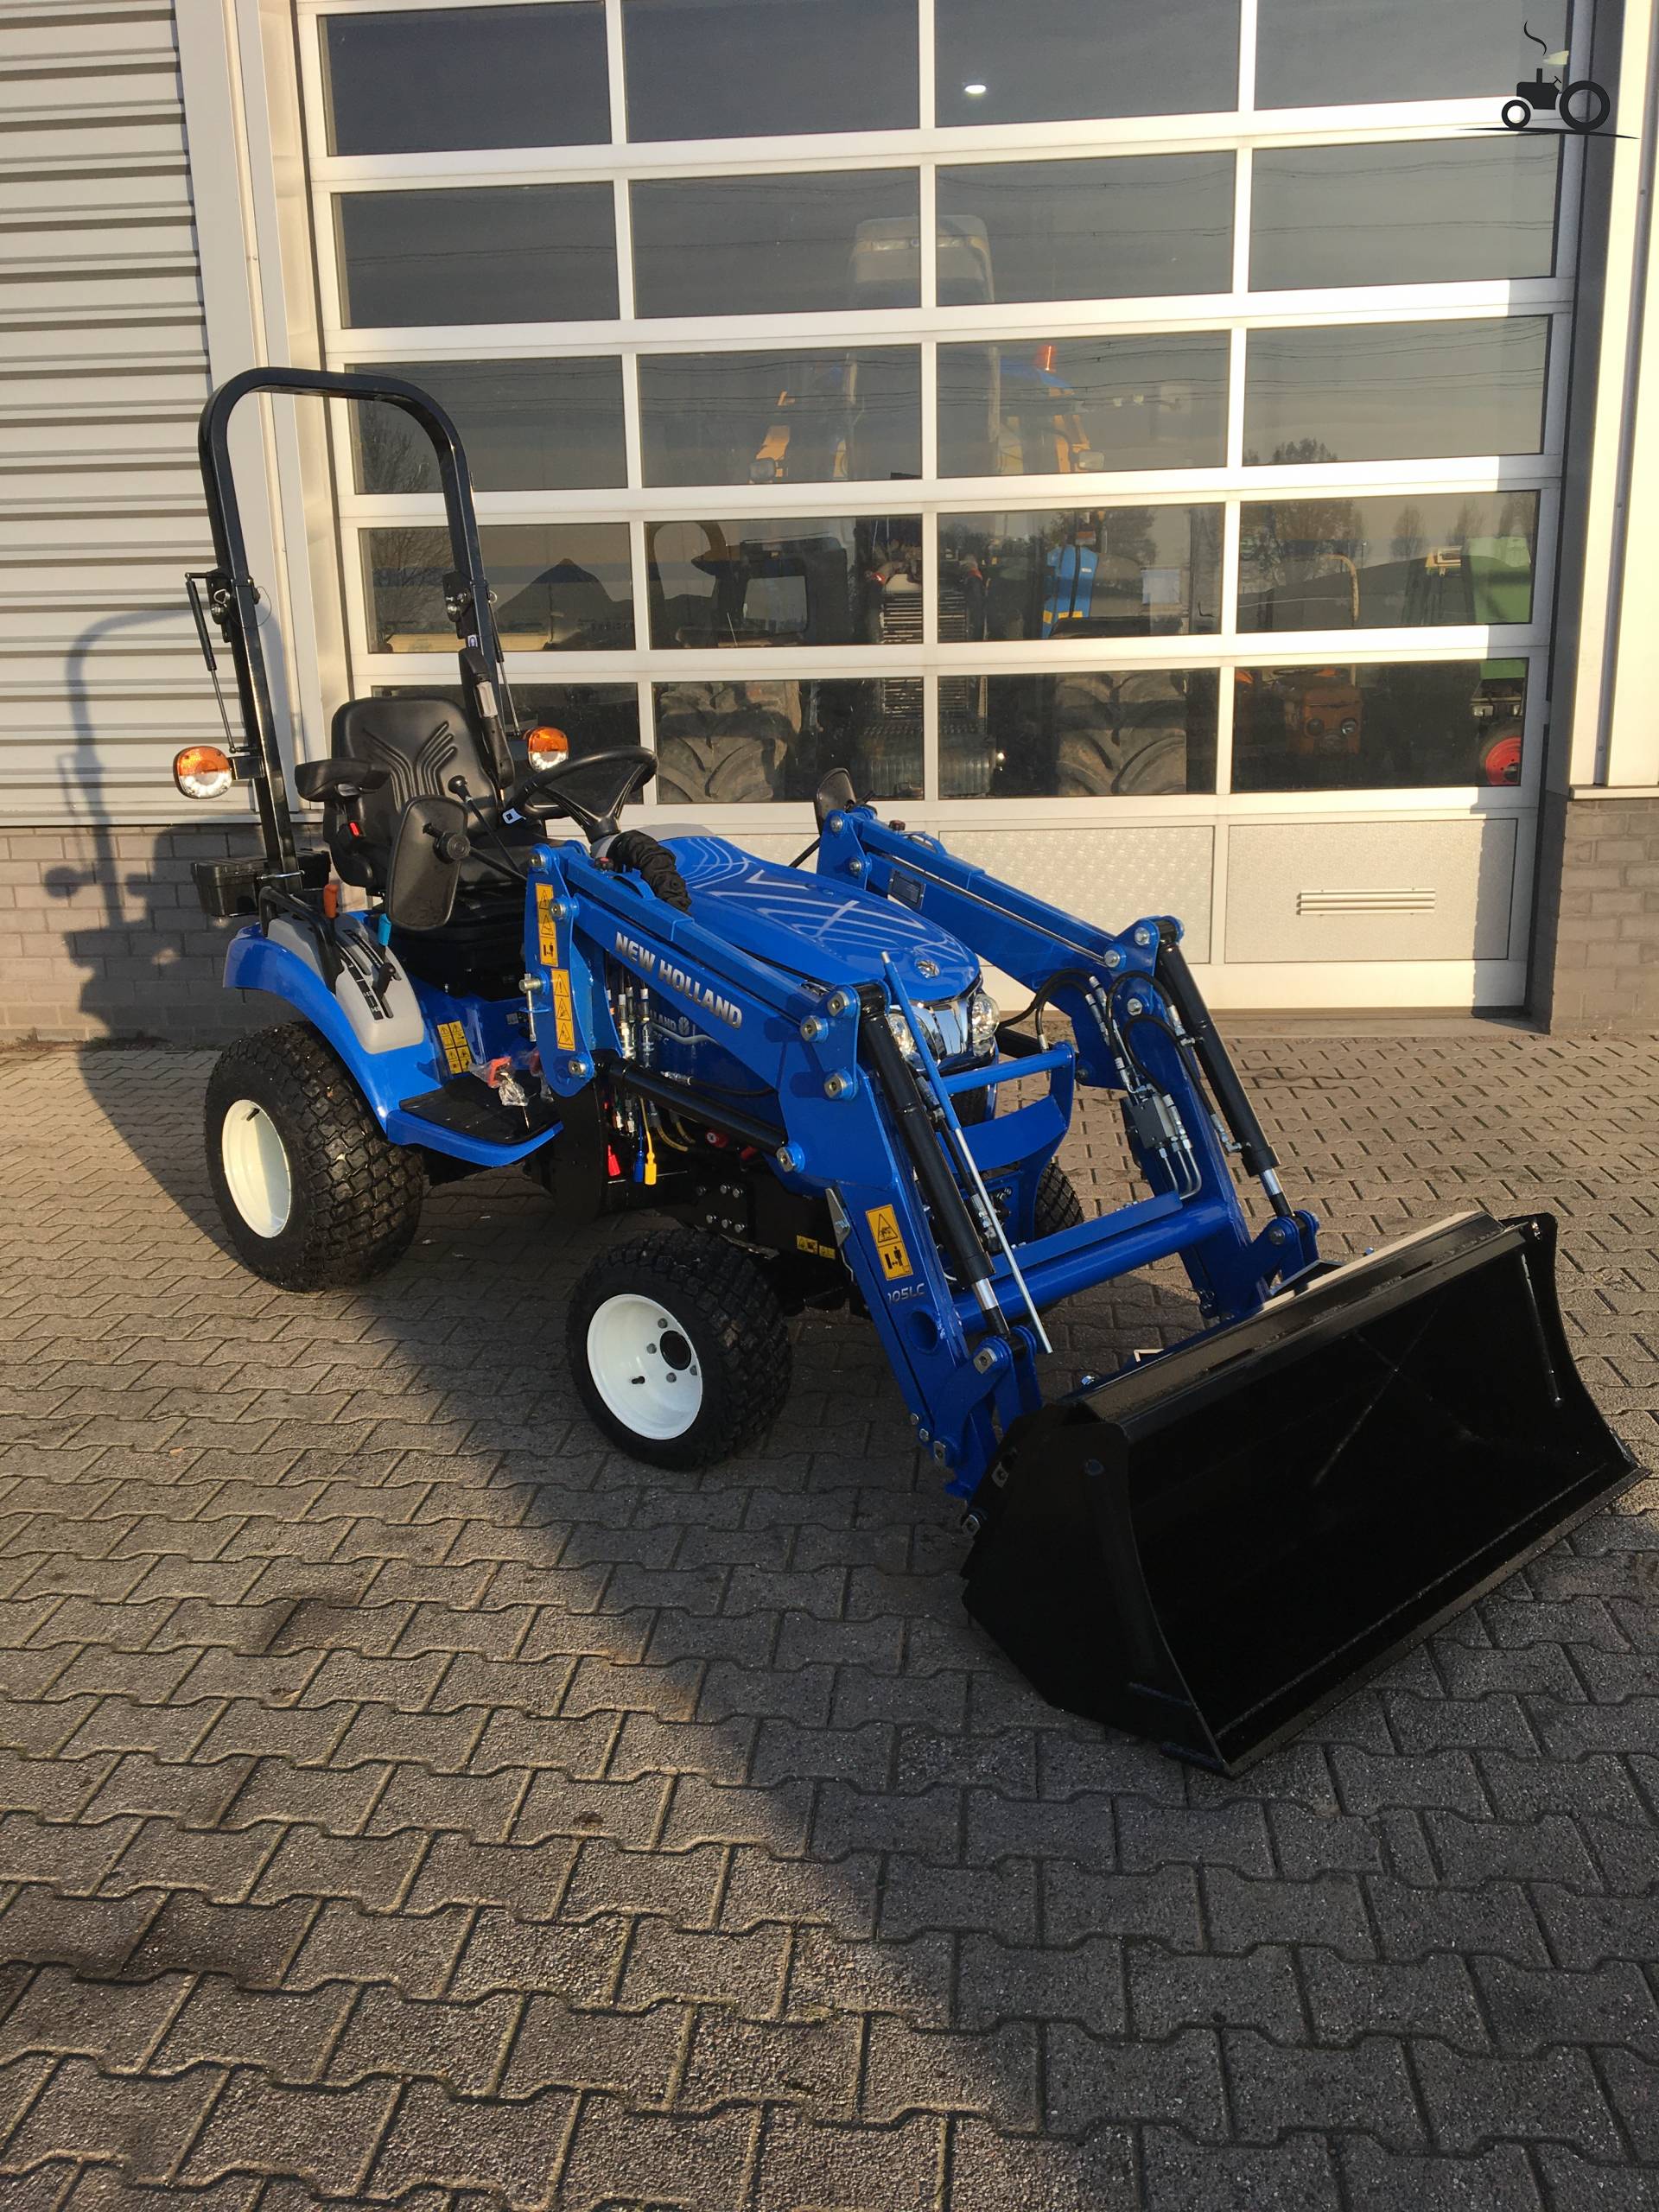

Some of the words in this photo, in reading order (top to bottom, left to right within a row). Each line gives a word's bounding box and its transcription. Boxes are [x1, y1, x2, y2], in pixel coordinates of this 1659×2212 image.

[616, 931, 655, 973] NEW
[658, 959, 743, 1029] HOLLAND
[650, 1009, 677, 1033] LLAND
